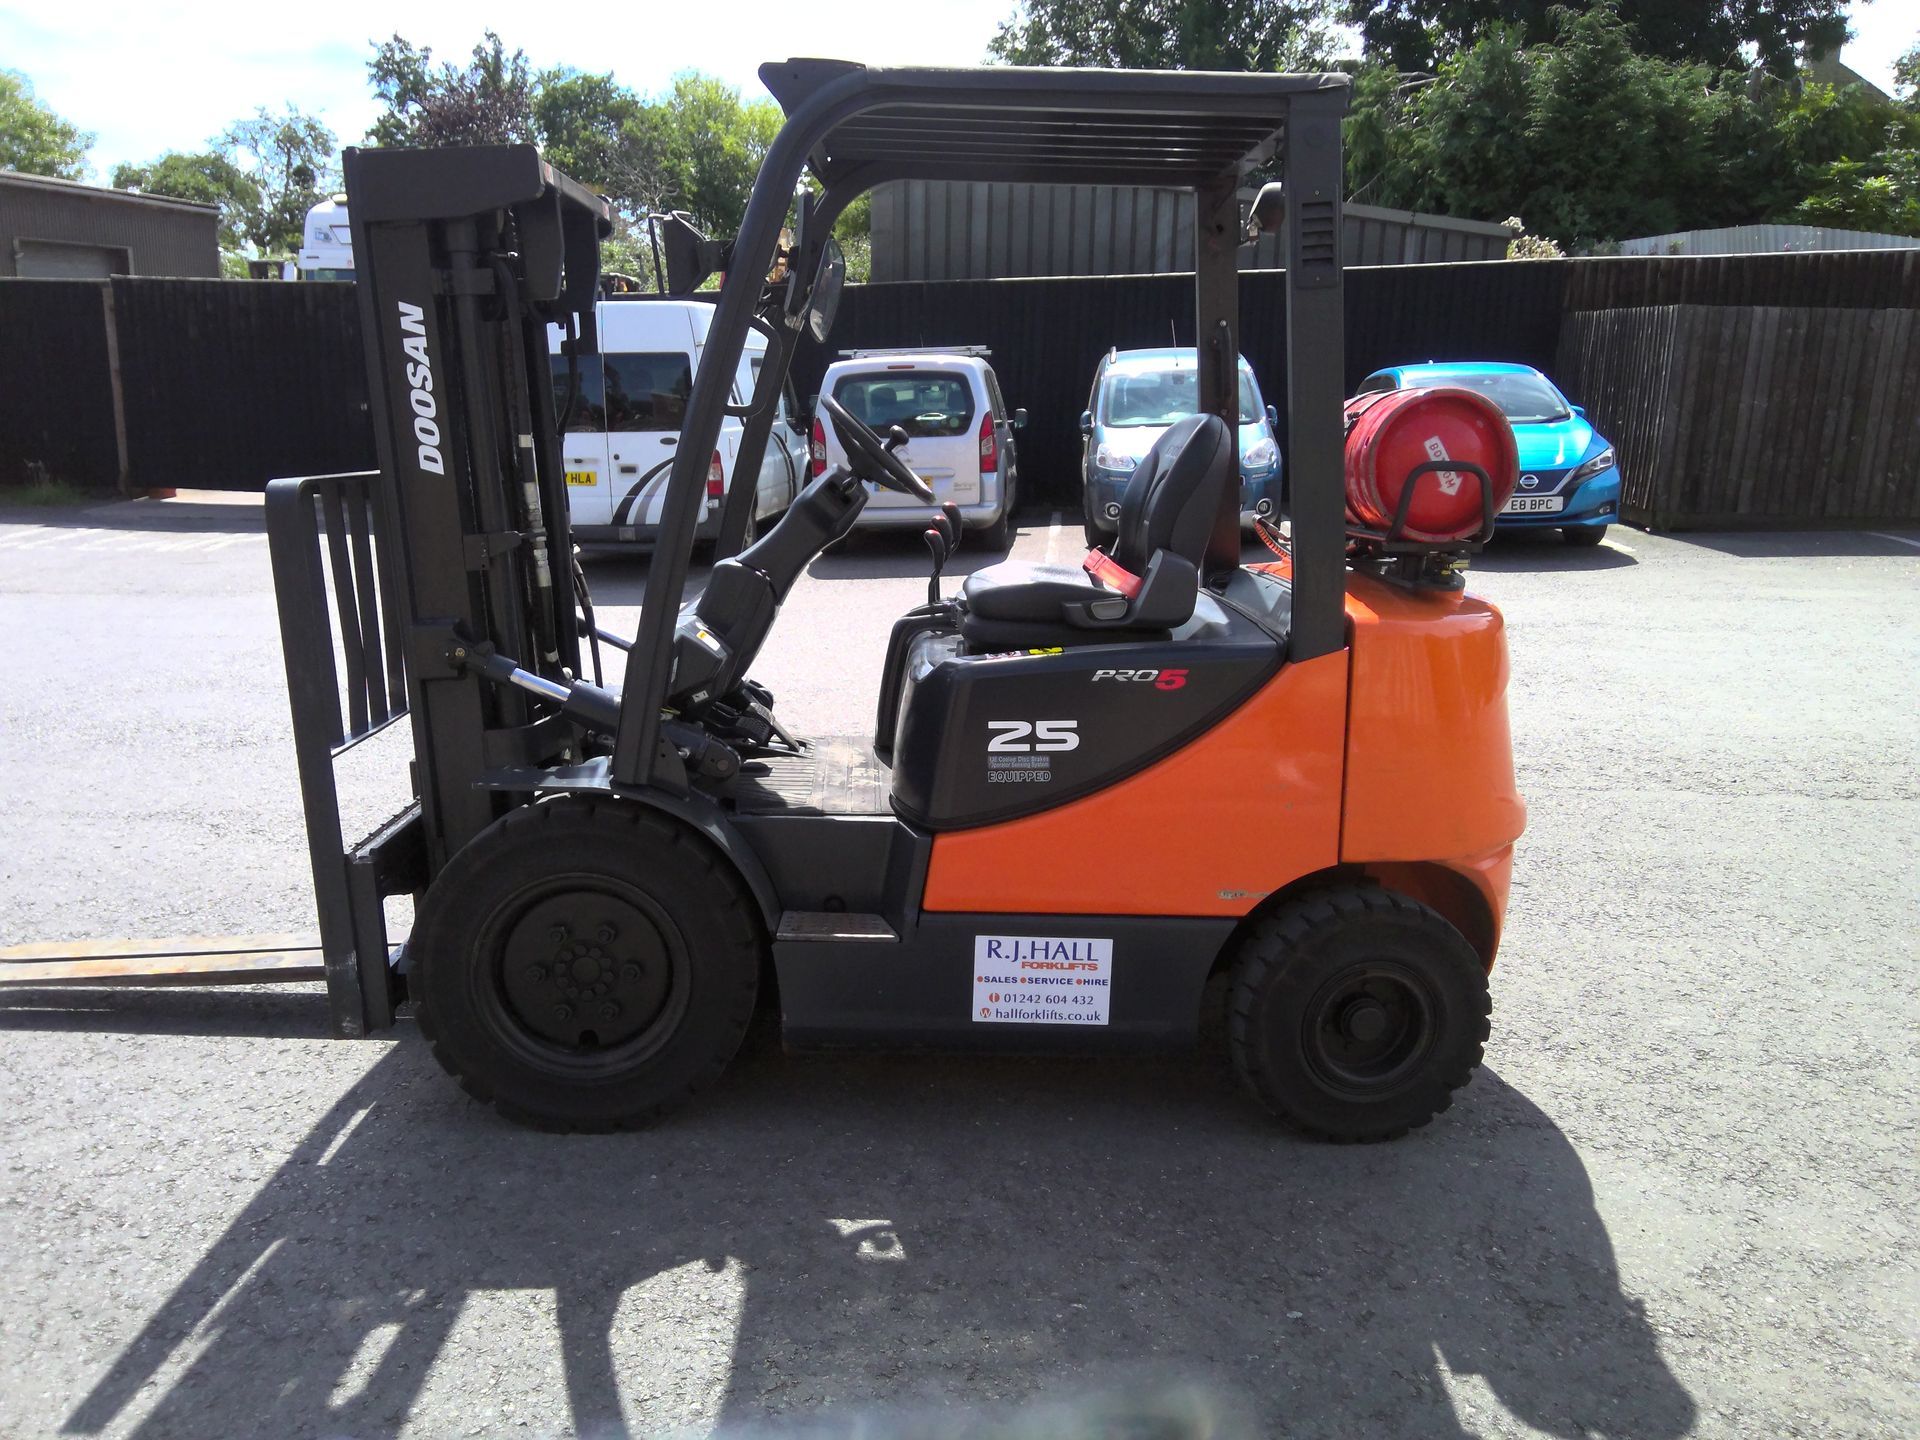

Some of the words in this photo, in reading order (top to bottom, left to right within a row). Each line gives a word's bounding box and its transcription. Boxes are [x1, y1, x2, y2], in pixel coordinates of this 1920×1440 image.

[398, 301, 445, 475] DOOSAN
[1429, 443, 1456, 488] BOOM
[570, 473, 592, 483] HLA
[1511, 500, 1527, 510] E8
[1530, 499, 1553, 510] BPC
[987, 720, 1080, 752] 25
[988, 770, 1051, 783] EQUIPPED
[987, 939, 1099, 962] R.J.HALL
[1021, 961, 1099, 971] FORKLIFTS
[984, 976, 1018, 984] SALES
[1027, 977, 1074, 986] SERVICE
[1083, 978, 1109, 986] HIRE
[1004, 993, 1041, 1004] 01242
[1045, 995, 1067, 1005] 604
[1072, 995, 1094, 1005] 432
[995, 1008, 1101, 1022] hallforklifts.co.uk
